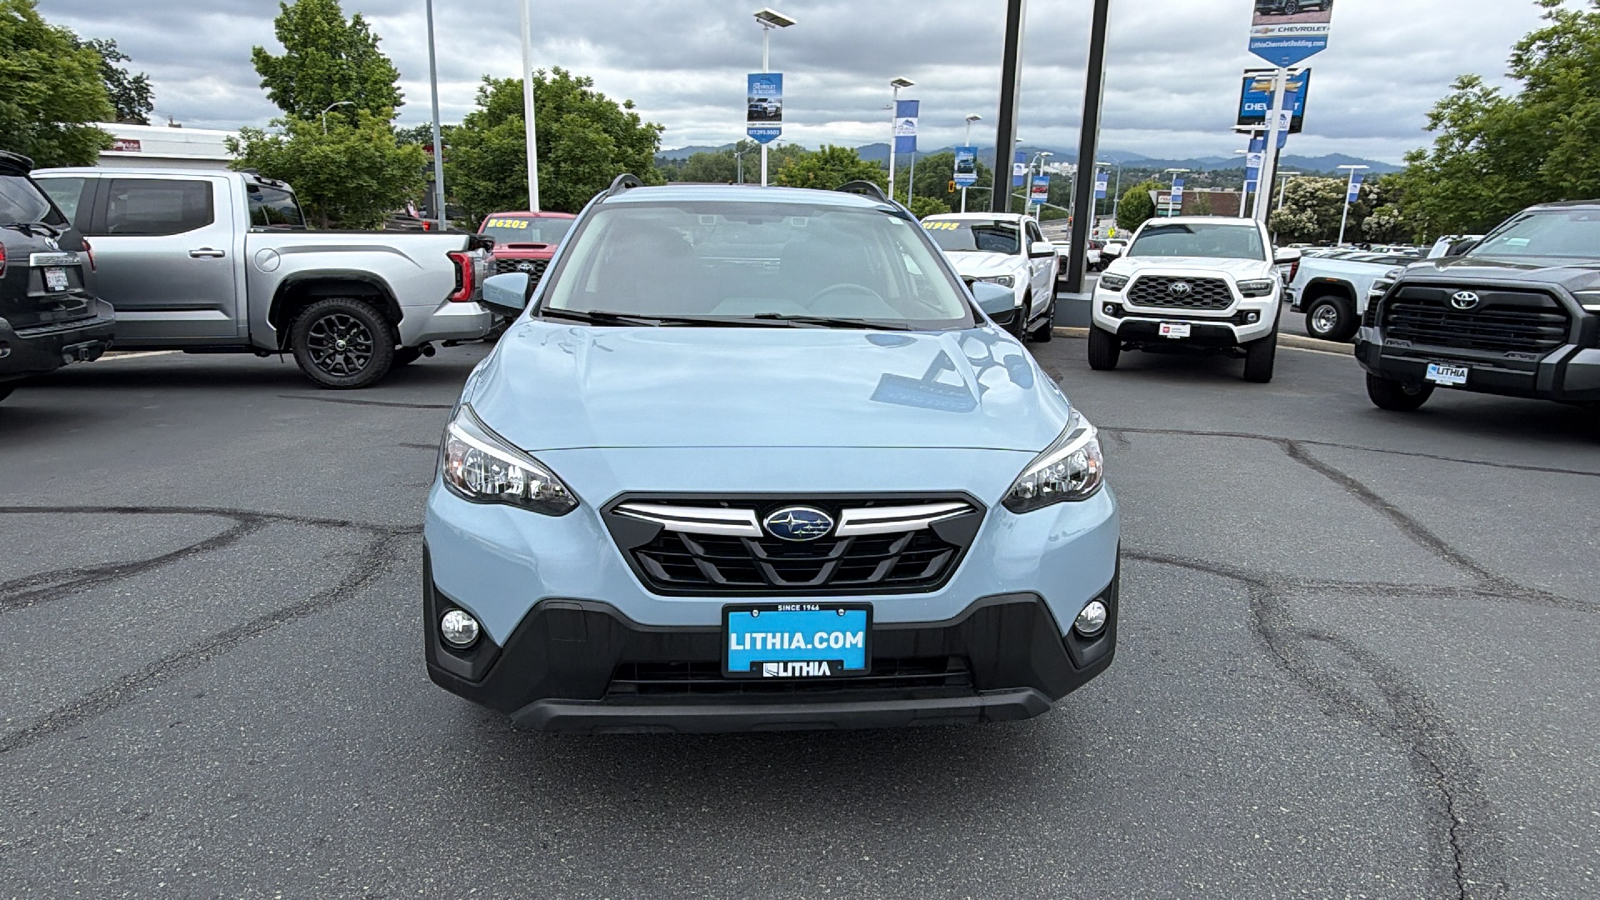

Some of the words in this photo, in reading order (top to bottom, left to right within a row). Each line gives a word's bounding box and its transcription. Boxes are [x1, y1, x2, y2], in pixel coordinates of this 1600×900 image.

[1251, 40, 1325, 49] LithiaChevroletRedding.com
[1437, 367, 1465, 378] LITHIA
[730, 631, 864, 650] LITHIA.COM
[778, 661, 831, 677] LITHIA
